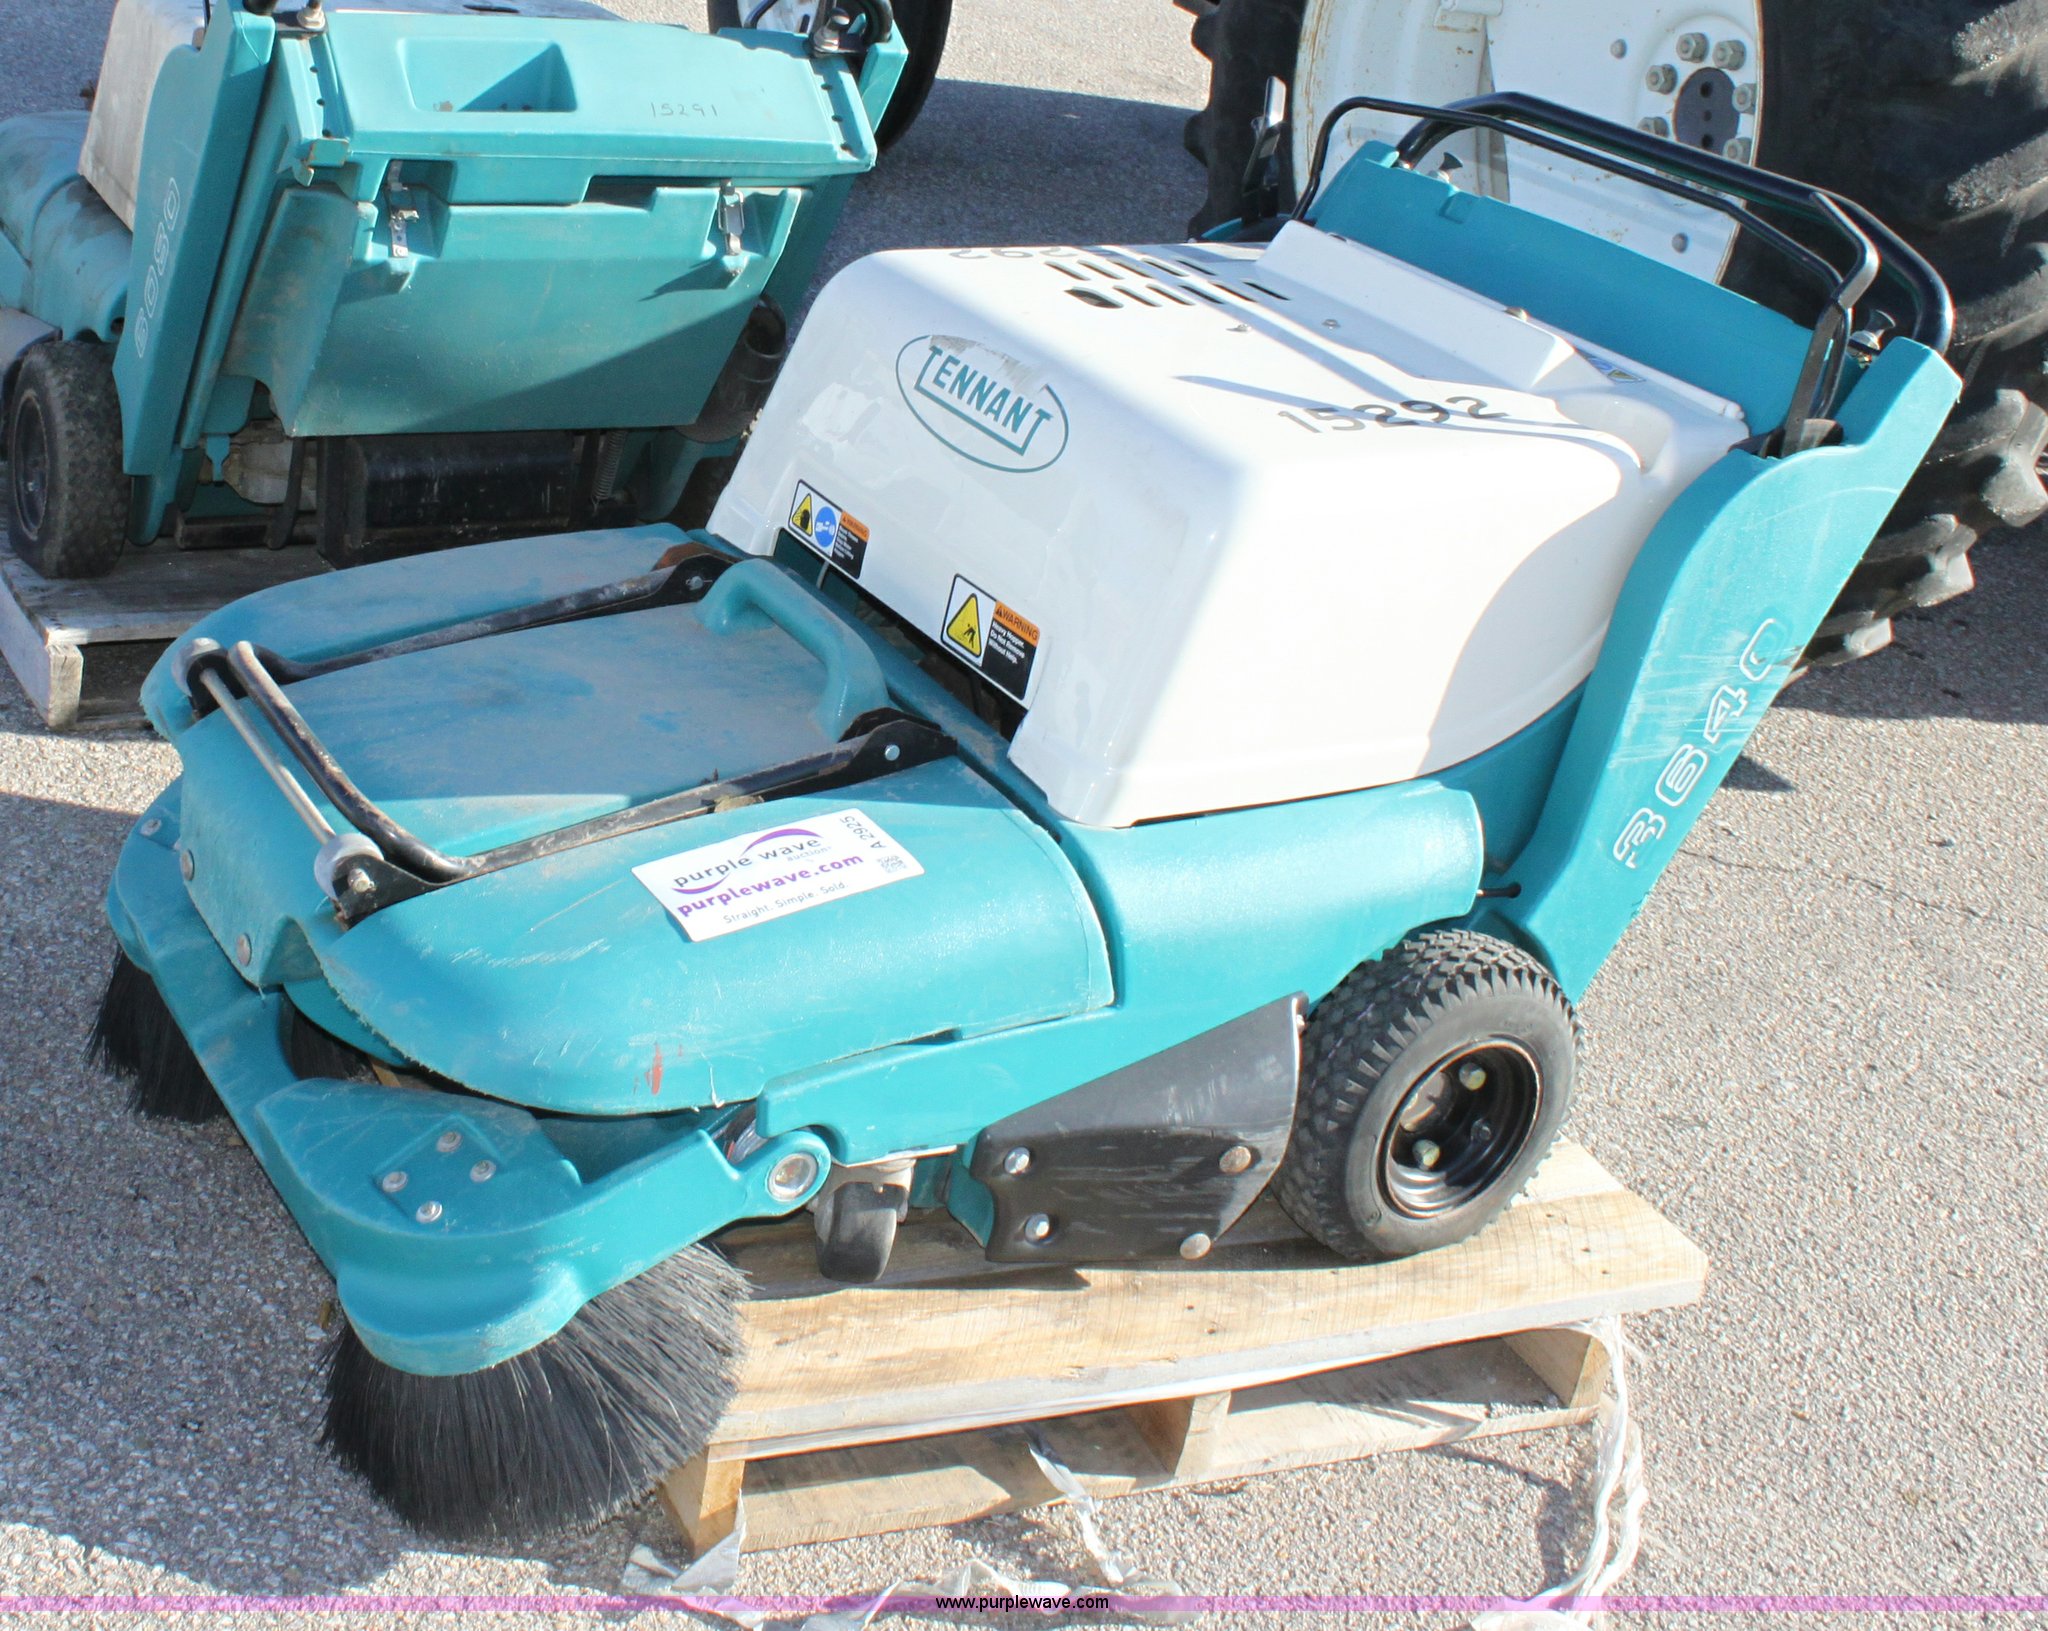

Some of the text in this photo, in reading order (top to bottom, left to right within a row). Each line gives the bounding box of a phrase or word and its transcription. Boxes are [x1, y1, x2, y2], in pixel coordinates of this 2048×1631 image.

[650, 102, 718, 118] 15291
[914, 345, 1054, 457] TENNANT
[1277, 395, 1511, 433] 15292
[1003, 608, 1039, 641] WARNING
[840, 815, 886, 850] A 2925
[673, 837, 822, 888] purple wave
[677, 853, 864, 917] purplewave.com
[724, 880, 849, 924] Straight. Simple. Sold.
